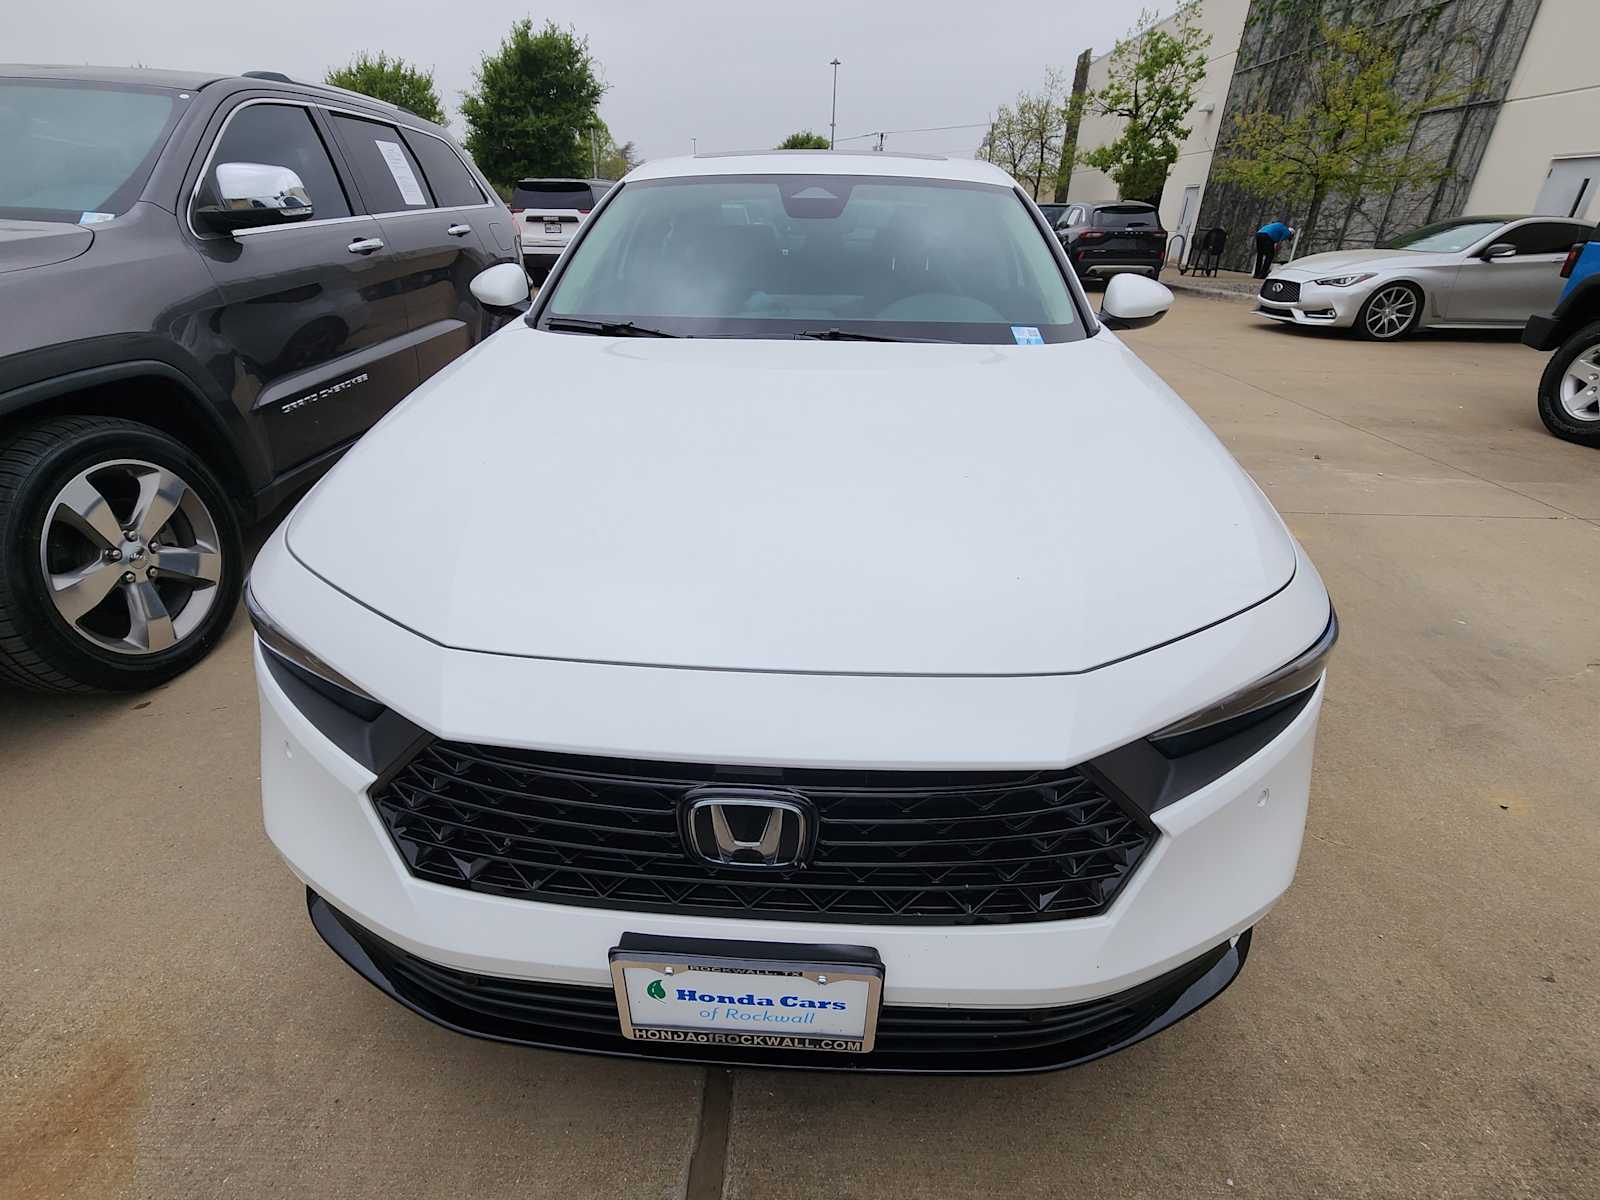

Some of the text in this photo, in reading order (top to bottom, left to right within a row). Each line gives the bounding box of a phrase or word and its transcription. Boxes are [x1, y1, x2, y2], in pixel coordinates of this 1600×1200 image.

[676, 989, 847, 1011] Honda Cars
[699, 1007, 816, 1025] of Rockwall
